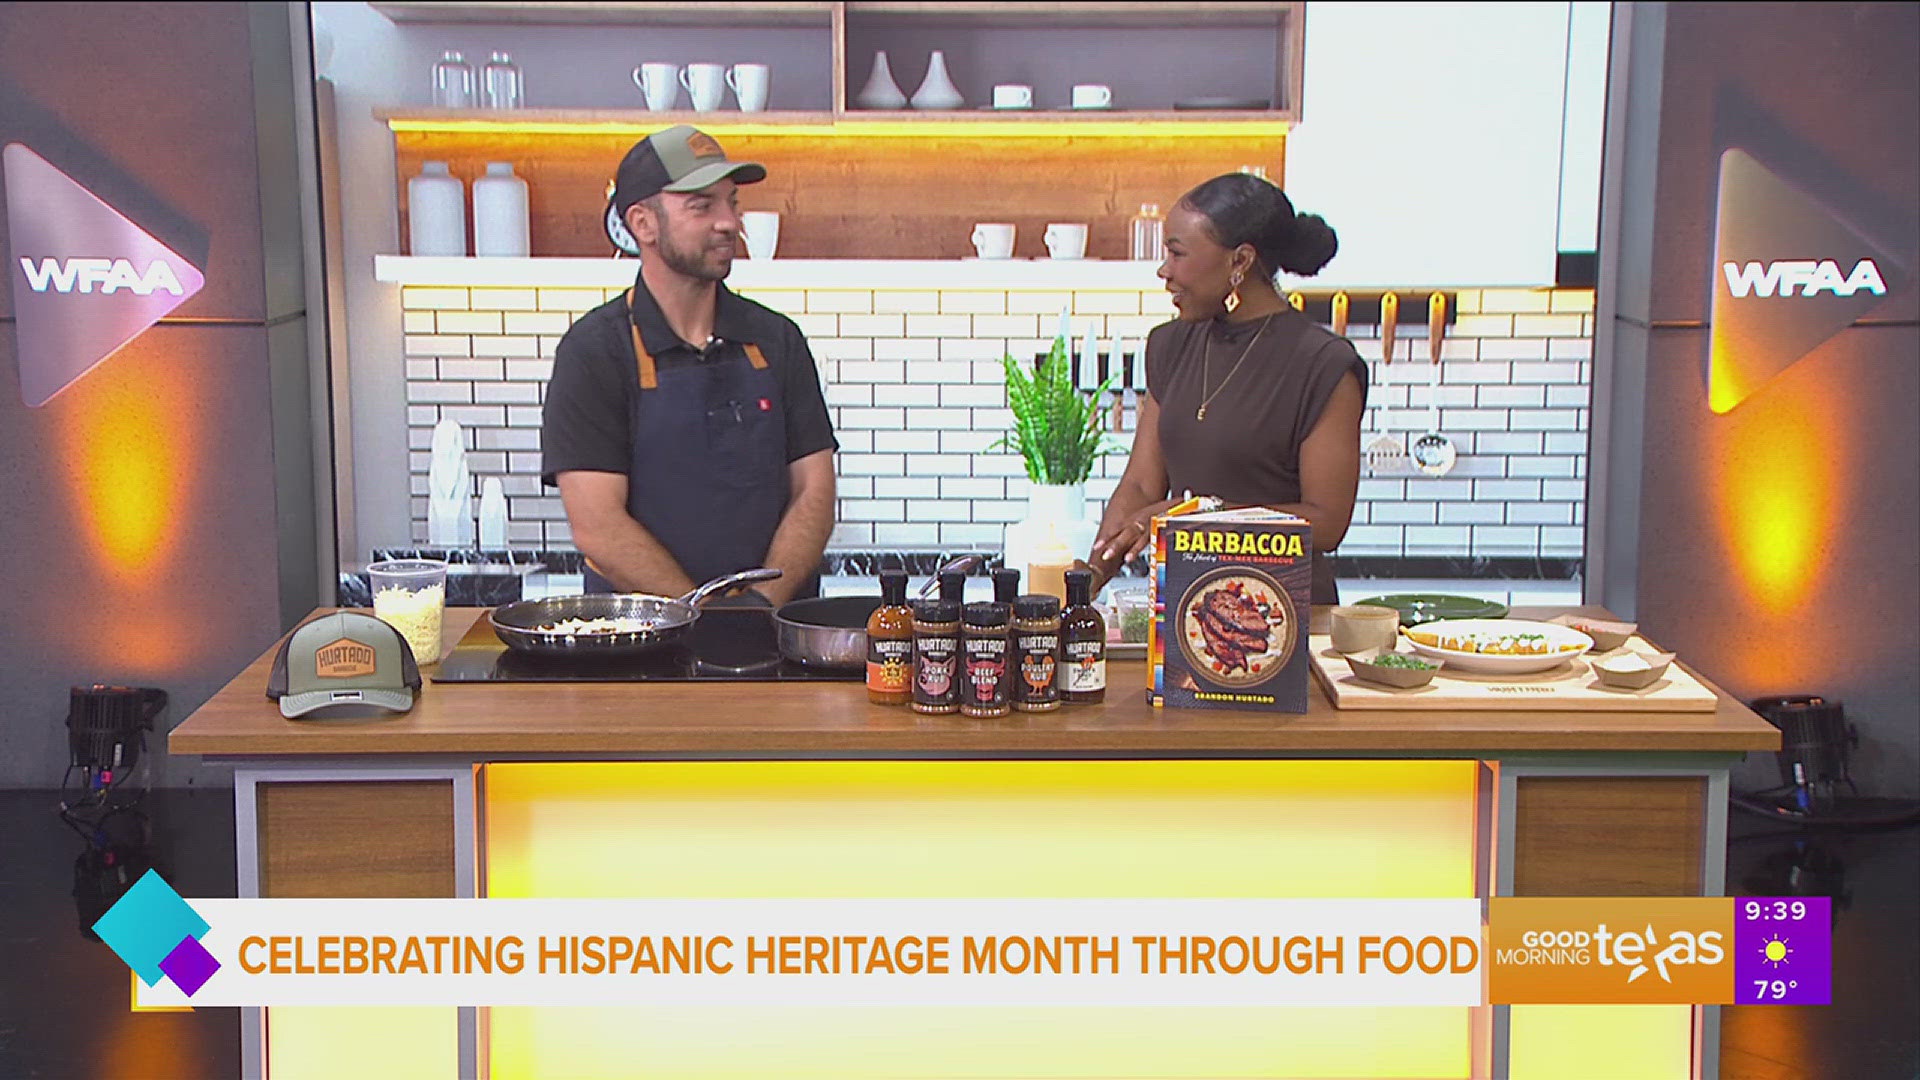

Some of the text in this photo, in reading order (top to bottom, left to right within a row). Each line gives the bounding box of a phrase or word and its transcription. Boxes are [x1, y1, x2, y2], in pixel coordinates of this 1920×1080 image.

[20, 256, 184, 296] WFAA
[1723, 259, 1887, 297] WFAA
[1174, 530, 1304, 557] BARBACOA
[1218, 554, 1252, 563] TEX-MEX
[1253, 555, 1295, 565] BARBECUE
[917, 638, 957, 652] HURTADO
[965, 639, 1006, 654] HURTADO
[1018, 636, 1058, 650] HURTADO
[318, 646, 371, 668] HURTADO
[974, 667, 994, 676] BEEF
[970, 675, 998, 685] BLEND
[1194, 692, 1275, 704] BRANDON HURTADO
